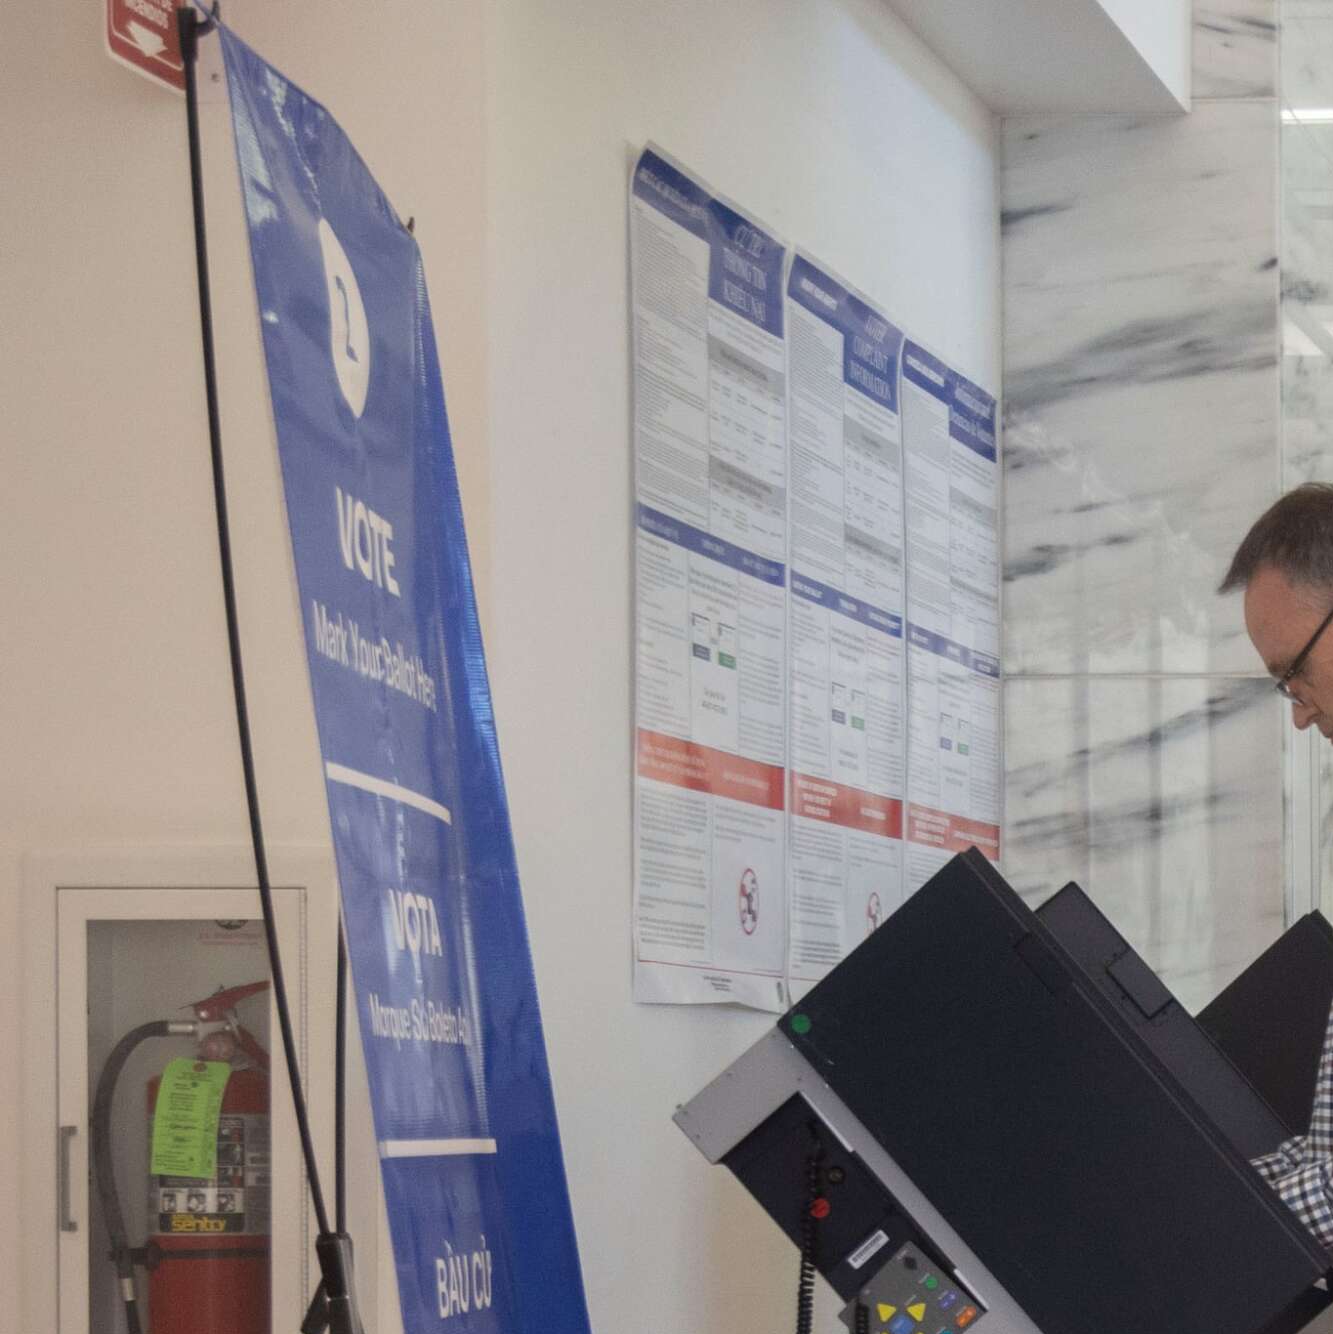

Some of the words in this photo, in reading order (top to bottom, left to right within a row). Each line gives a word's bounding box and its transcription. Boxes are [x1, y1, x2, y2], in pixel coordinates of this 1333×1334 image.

[336, 486, 401, 597] VOTE
[313, 600, 350, 668] Mark
[349, 619, 384, 682] Your
[389, 888, 443, 957] VOTA
